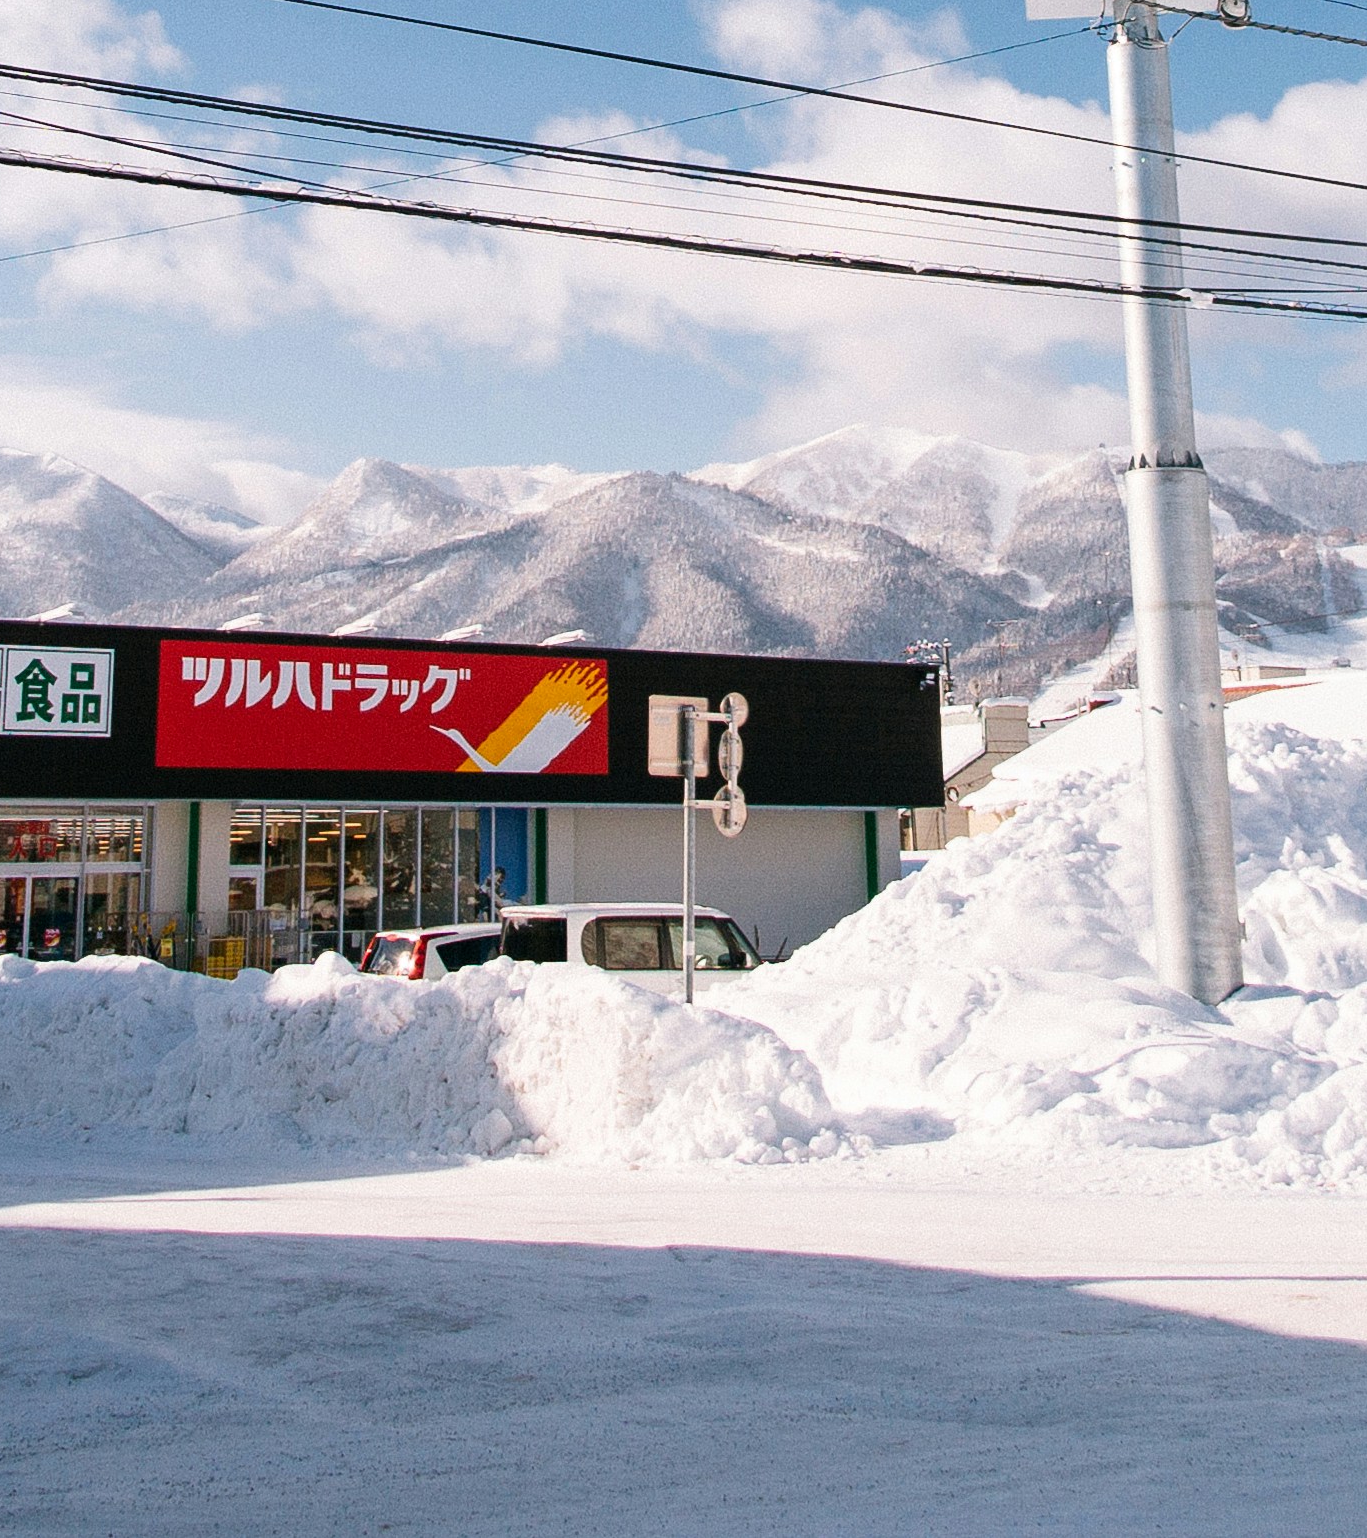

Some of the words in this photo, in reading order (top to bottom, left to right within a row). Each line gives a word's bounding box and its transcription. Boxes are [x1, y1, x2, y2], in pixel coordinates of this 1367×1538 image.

[15, 659, 102, 724] 食品
[182, 656, 471, 714] ツルハドラッグ
